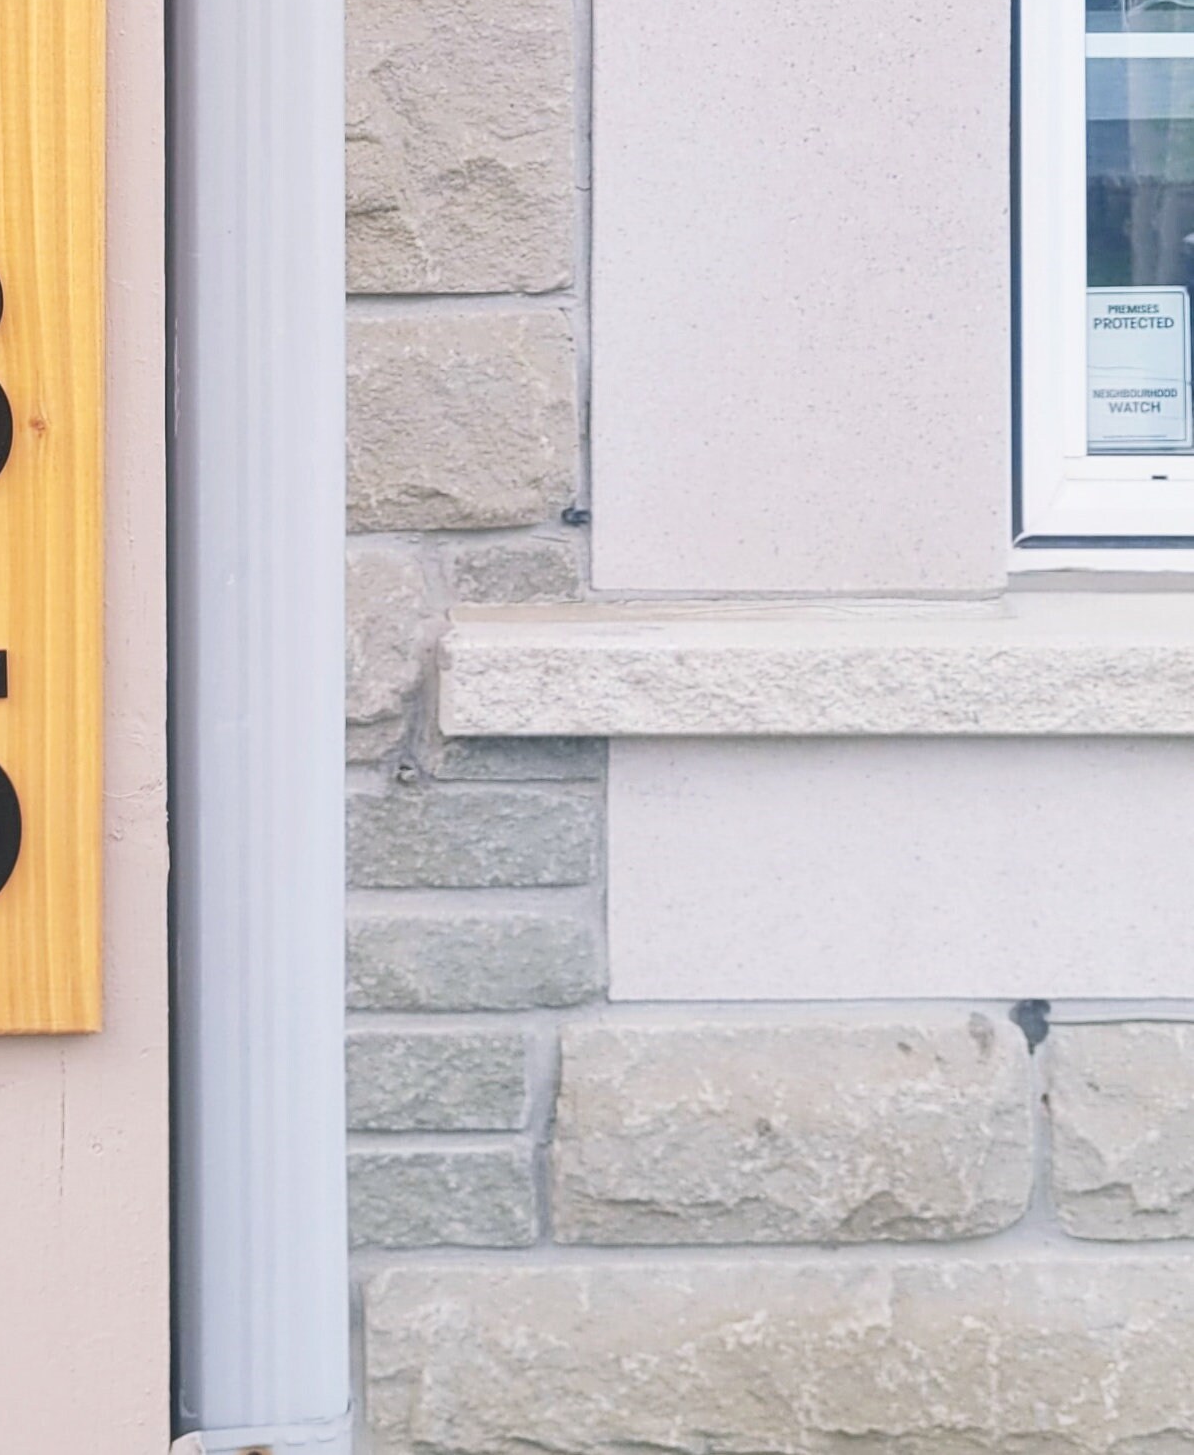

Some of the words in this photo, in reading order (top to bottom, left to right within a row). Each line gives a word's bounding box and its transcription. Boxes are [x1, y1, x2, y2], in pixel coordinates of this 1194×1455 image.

[1108, 304, 1159, 314] PREMISES
[1093, 317, 1174, 329] PROTECTED
[1093, 388, 1178, 399] NEIGHBOURHOOD
[1109, 401, 1161, 413] WATCH
